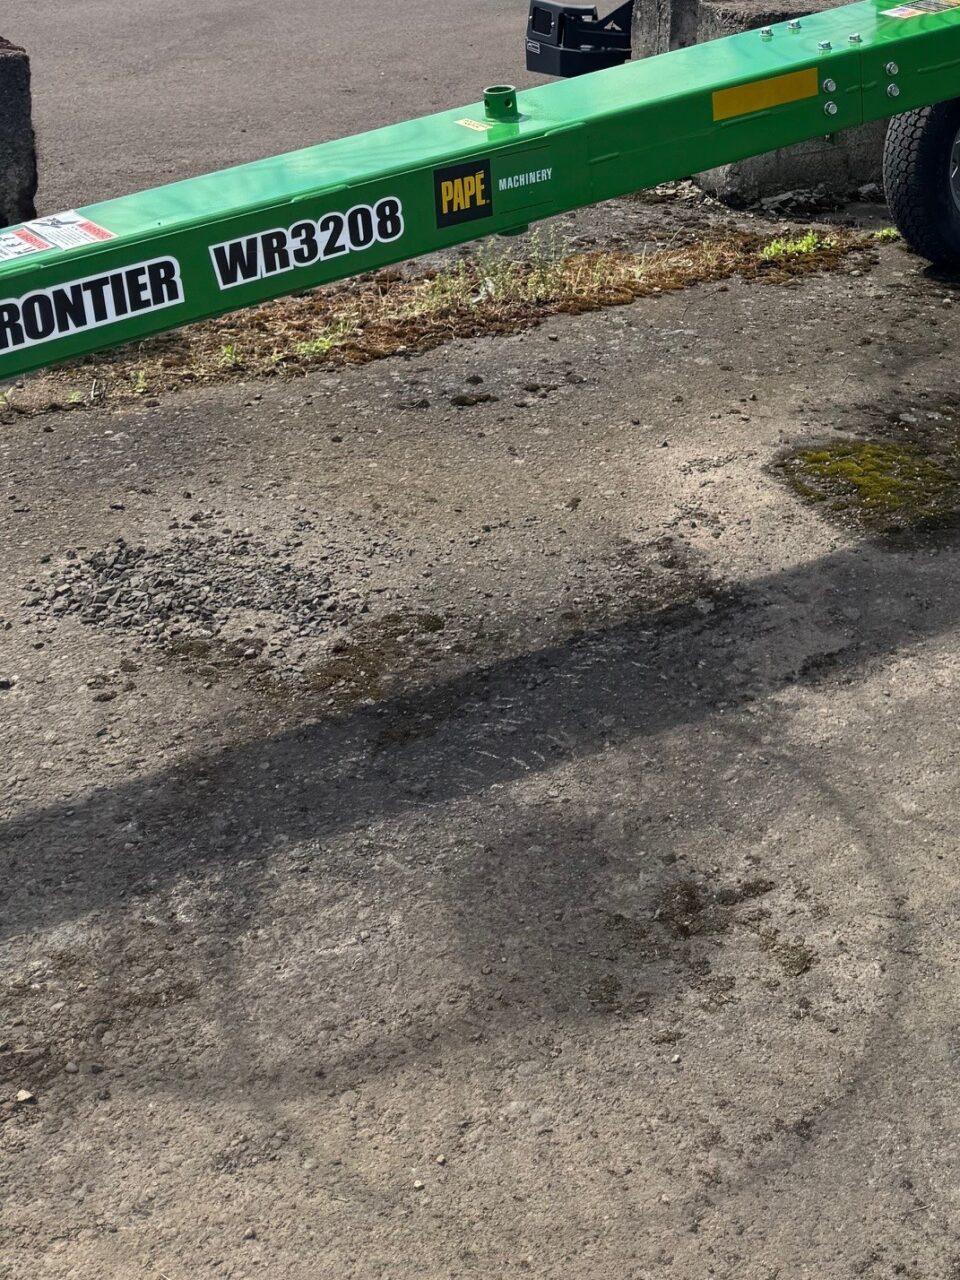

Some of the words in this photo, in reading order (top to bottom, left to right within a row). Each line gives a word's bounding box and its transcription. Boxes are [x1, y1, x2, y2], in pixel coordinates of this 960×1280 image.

[498, 167, 553, 192] MACHINERY
[0, 260, 179, 349] RONTIER
[213, 199, 402, 286] WR3208
